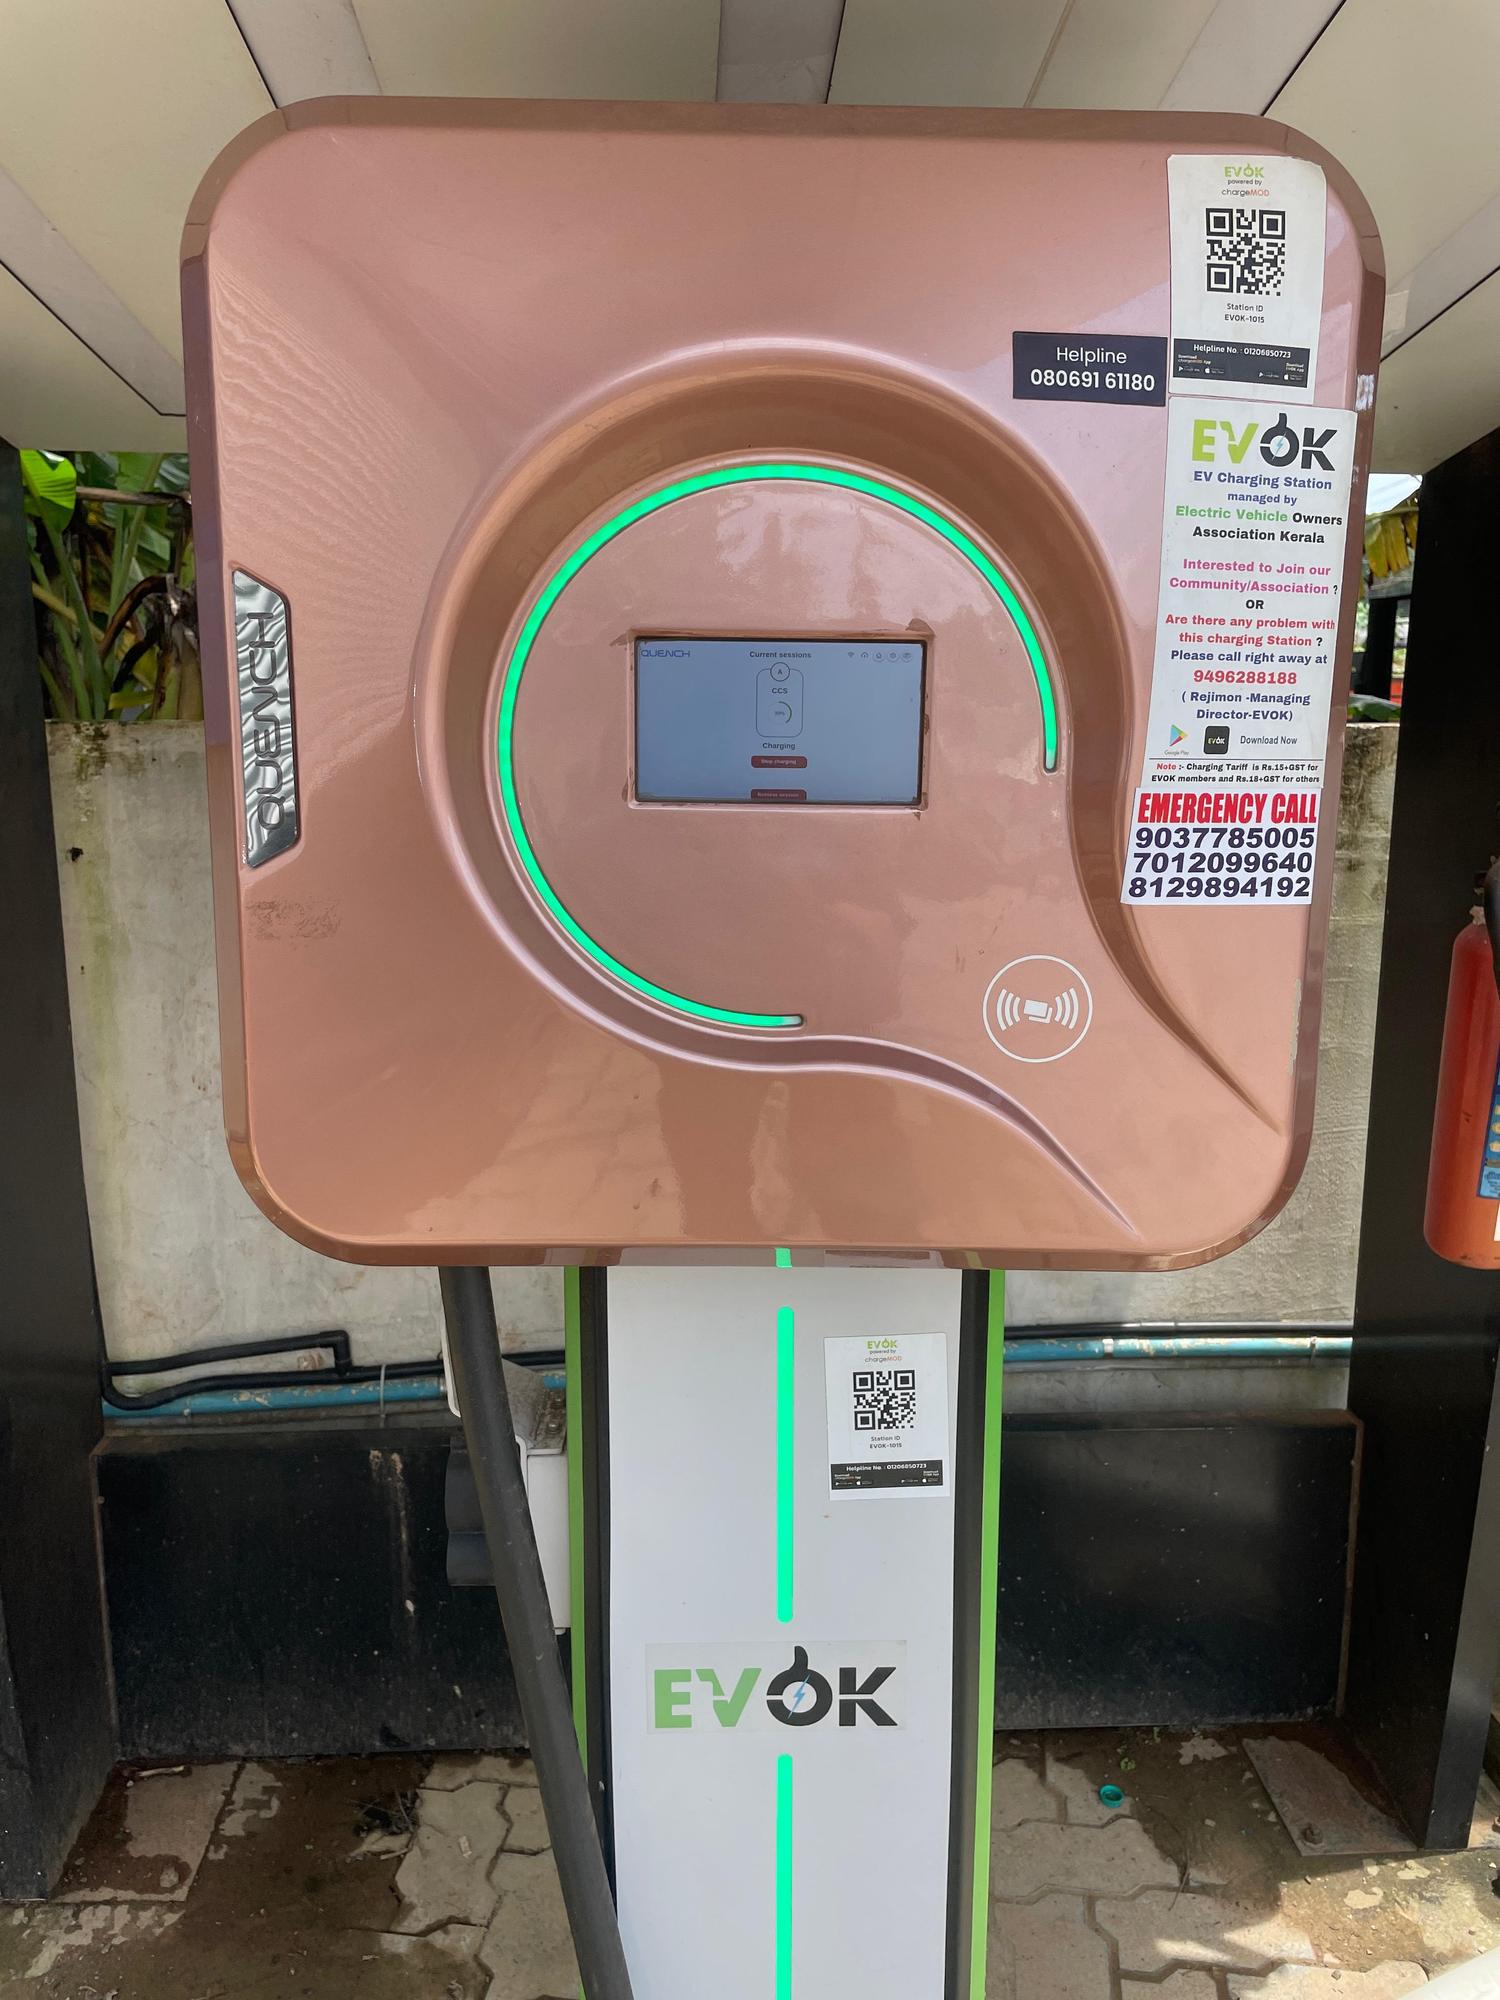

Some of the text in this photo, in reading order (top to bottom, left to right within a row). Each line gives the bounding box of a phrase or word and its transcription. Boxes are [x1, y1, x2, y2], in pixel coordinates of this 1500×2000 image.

[1224, 163, 1264, 178] EVOK
[1221, 188, 1270, 197] chargeMOD
[1227, 303, 1254, 311] Station
[1224, 314, 1265, 323] EVOK-1015
[1056, 347, 1127, 366] Helpline
[1193, 344, 1225, 354] Helpline
[1030, 368, 1155, 391] 080691 61180
[1191, 412, 1338, 471] EVOK
[1193, 471, 1332, 490] EV Charging Station
[1227, 493, 1297, 506] managed by
[1175, 505, 1343, 525] Electric Vehicle Owners
[1192, 526, 1325, 544] Association Kerala
[1183, 558, 1331, 576] Interested to Join our
[1169, 577, 1338, 595] Community/Association ?
[1245, 599, 1264, 610] OR
[1165, 614, 1335, 632] Are there any problem with
[1179, 632, 1323, 648] this charging Station ?
[640, 649, 690, 658] QUENCH
[749, 650, 812, 659] Current sessions
[1171, 650, 1328, 666] Please call right away at
[1193, 669, 1297, 685] 9496288188
[771, 687, 788, 695] CCS
[1190, 692, 1242, 704] Rejimon
[247, 612, 285, 830] QUENCH
[1196, 709, 1293, 722] Director-EVOK)
[762, 742, 796, 750] Charging
[1207, 735, 1298, 745] EVOK Download Now
[1186, 763, 1224, 772] Charging
[1226, 763, 1248, 771] Tariff
[1307, 764, 1318, 772] for
[1236, 775, 1280, 783] Rs.18+GST
[1282, 775, 1294, 783] for
[1295, 775, 1320, 783] others
[1137, 793, 1317, 824] EMERGENCY CALL
[1135, 827, 1315, 848] 9037785005
[1133, 852, 1312, 873] 7012099640
[1128, 876, 1311, 897] 8129894192
[867, 1337, 897, 1349] EVOK
[654, 1645, 898, 1729] EVOK
